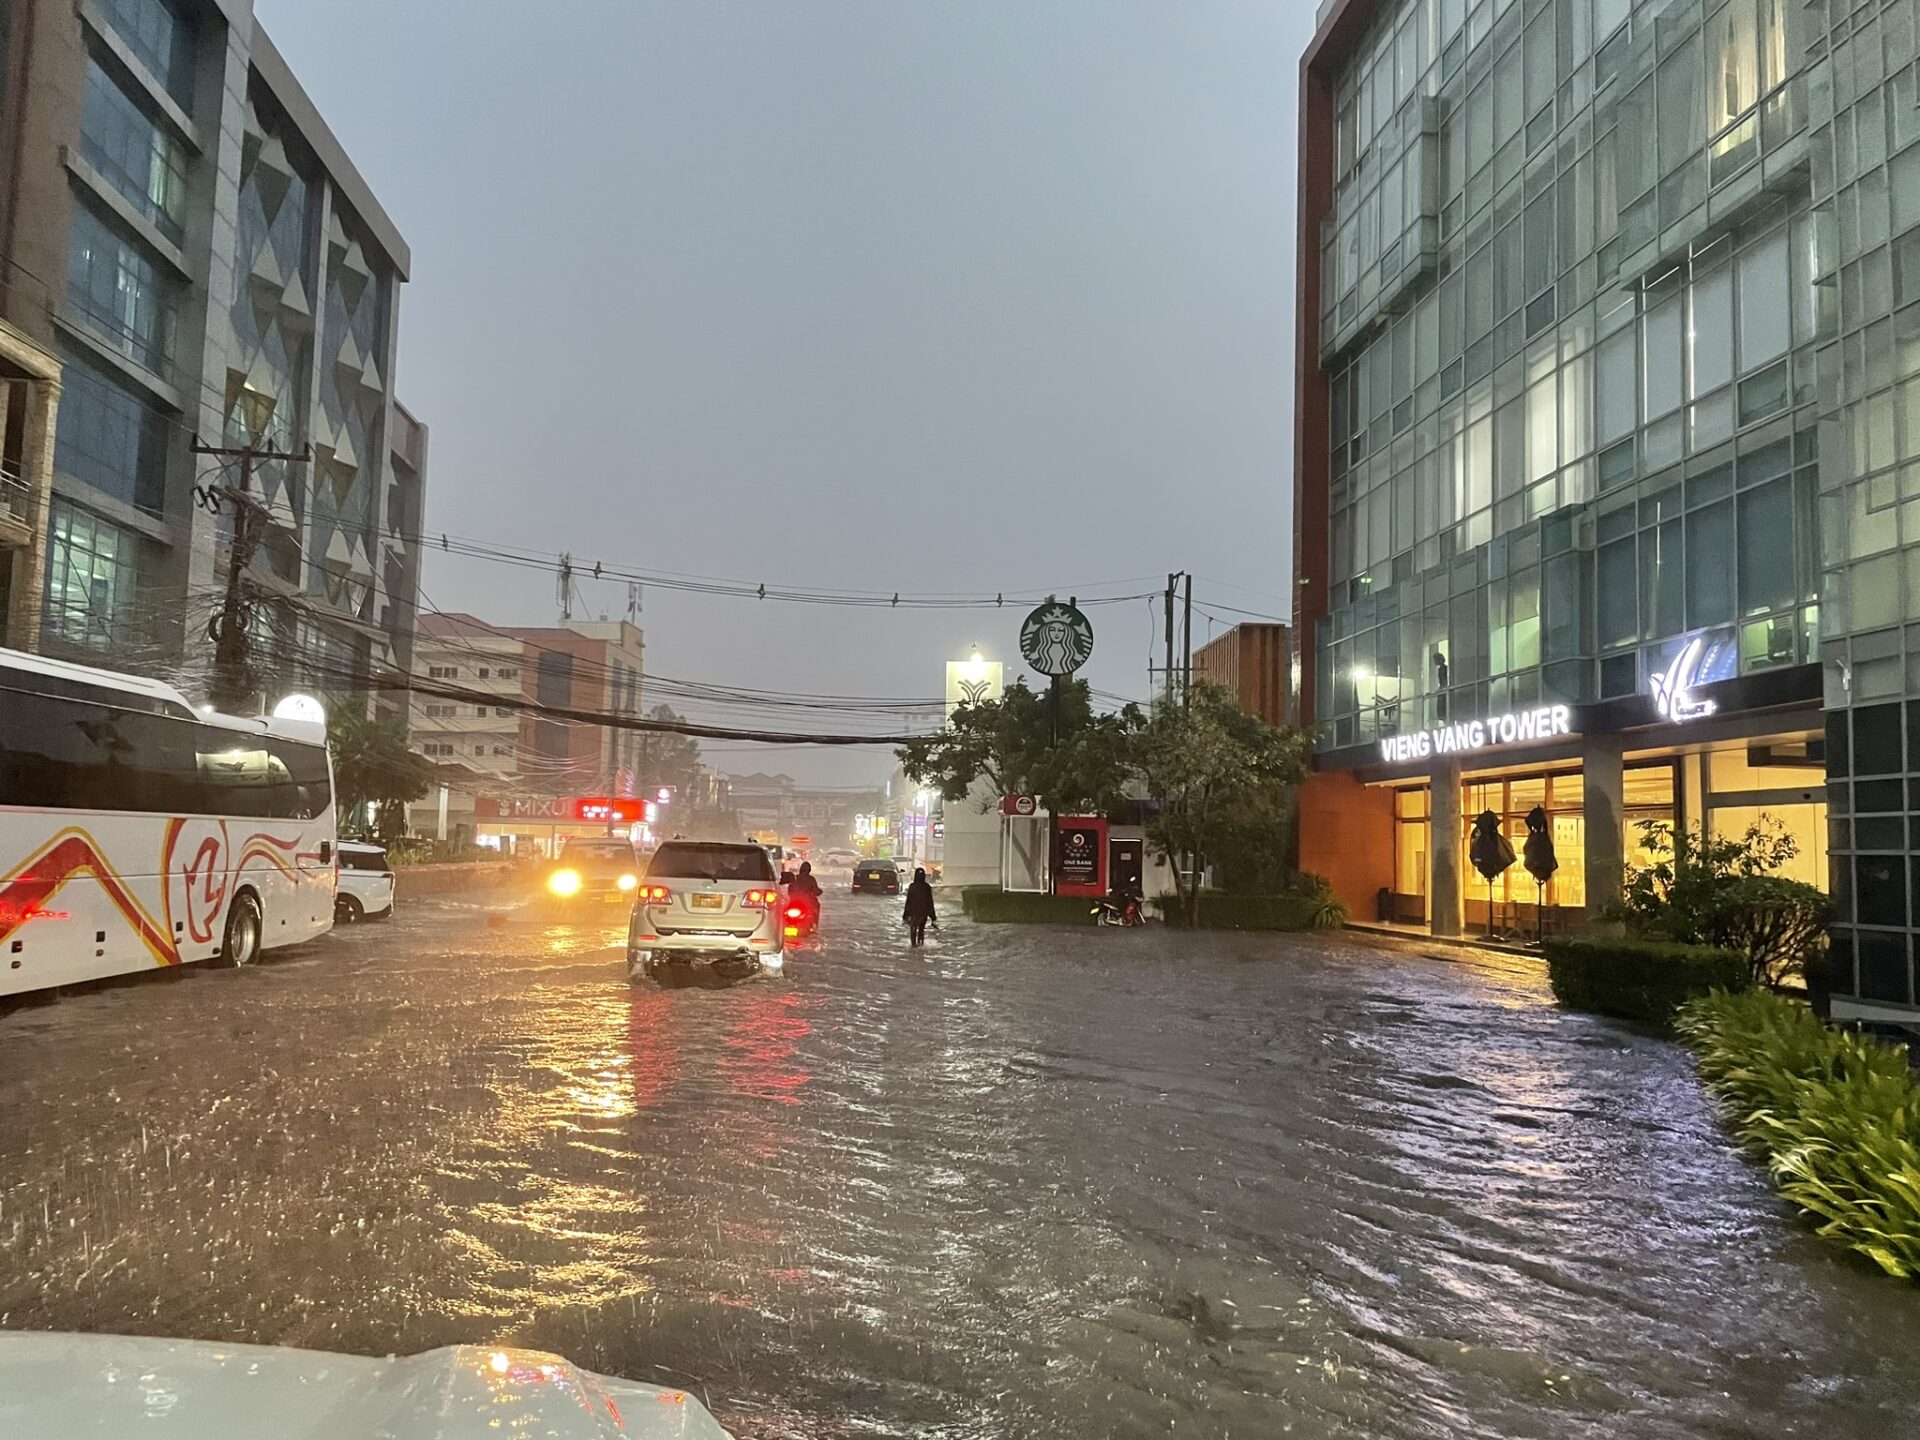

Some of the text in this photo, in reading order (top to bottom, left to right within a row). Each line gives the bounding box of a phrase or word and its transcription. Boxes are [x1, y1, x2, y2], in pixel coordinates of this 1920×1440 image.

[1380, 704, 1570, 762] VIENG VANG TOWER
